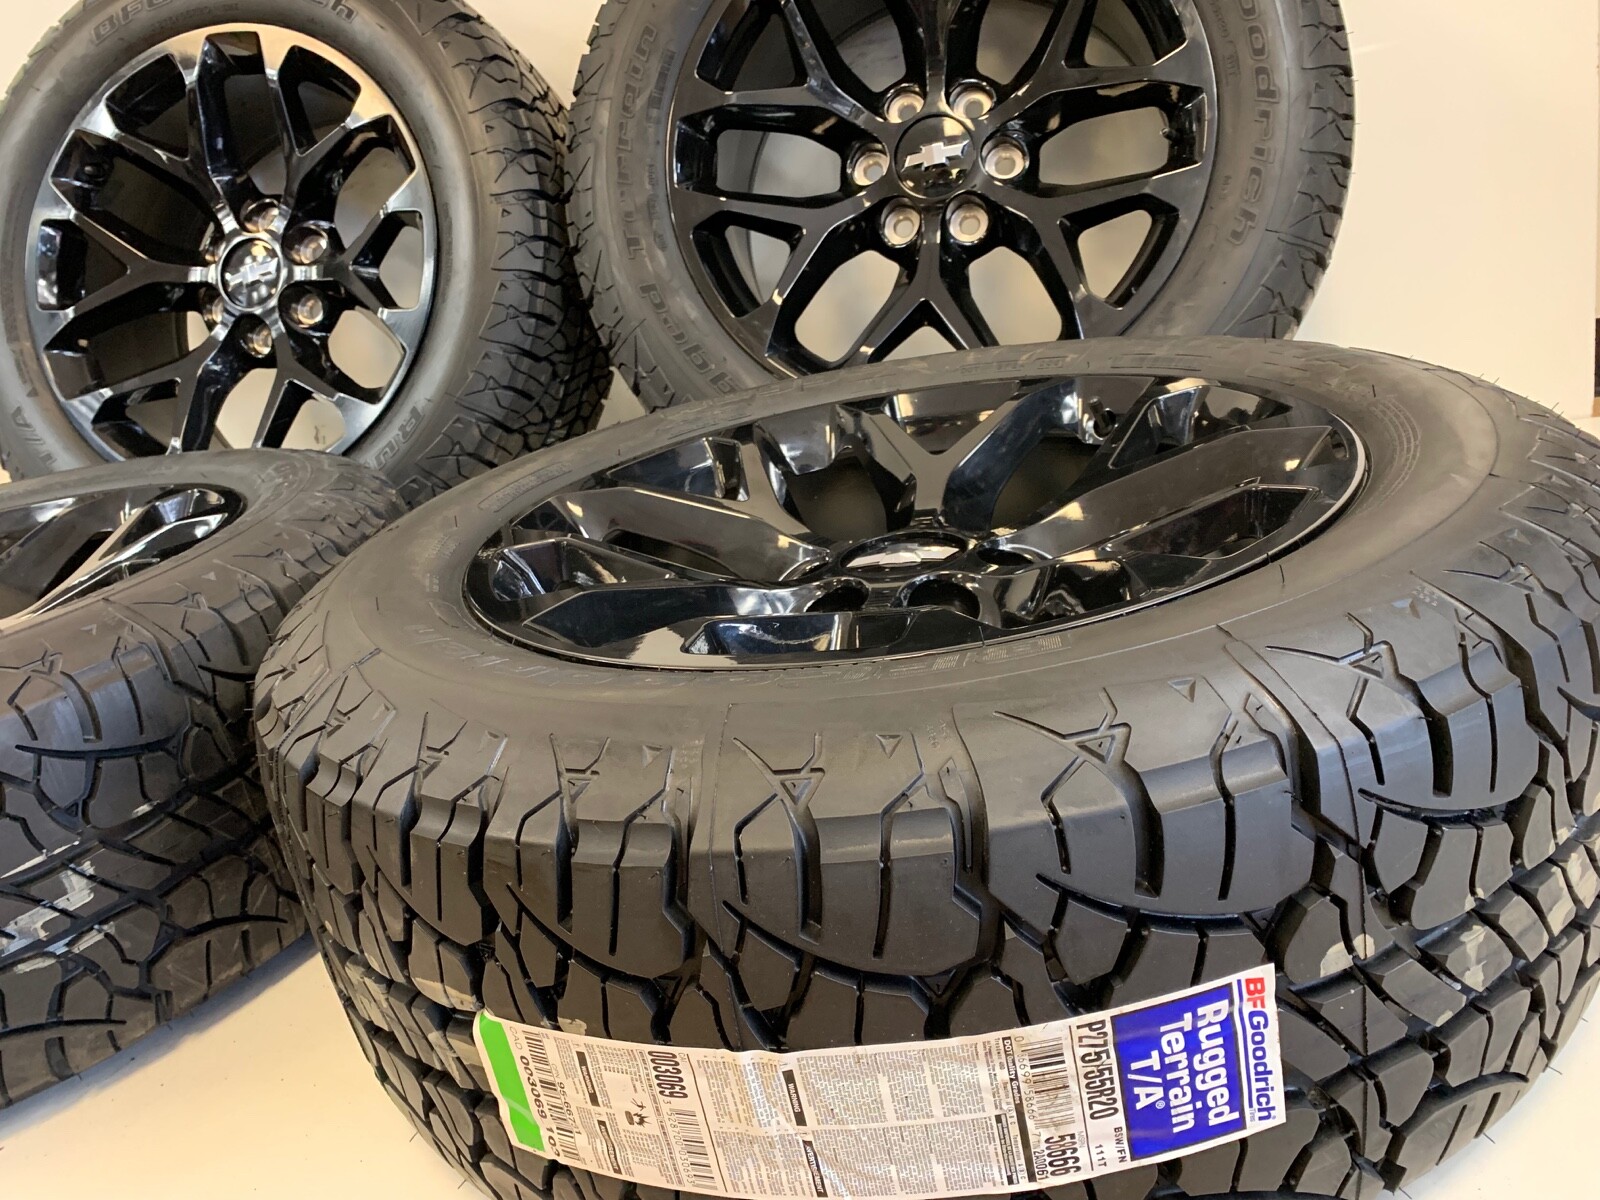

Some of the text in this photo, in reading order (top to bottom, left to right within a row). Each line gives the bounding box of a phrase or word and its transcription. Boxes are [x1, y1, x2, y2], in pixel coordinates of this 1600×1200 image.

[1003, 1039, 1012, 1058] DOT
[1006, 1056, 1017, 1081] Quality
[1077, 1019, 1120, 1121] P275/55R20
[1197, 999, 1240, 1127] Rugged
[1245, 977, 1277, 1122] BFGoodrich
[519, 1055, 548, 1120] 003069
[647, 1050, 689, 1099] 003069
[1159, 1012, 1195, 1133] Terrain
[788, 1083, 801, 1113] WARNING
[1033, 1150, 1049, 1181] 2A0061
[1045, 1133, 1082, 1177] 58666
[1094, 1144, 1108, 1168] 111T
[1113, 1127, 1128, 1163] BSW/FN
